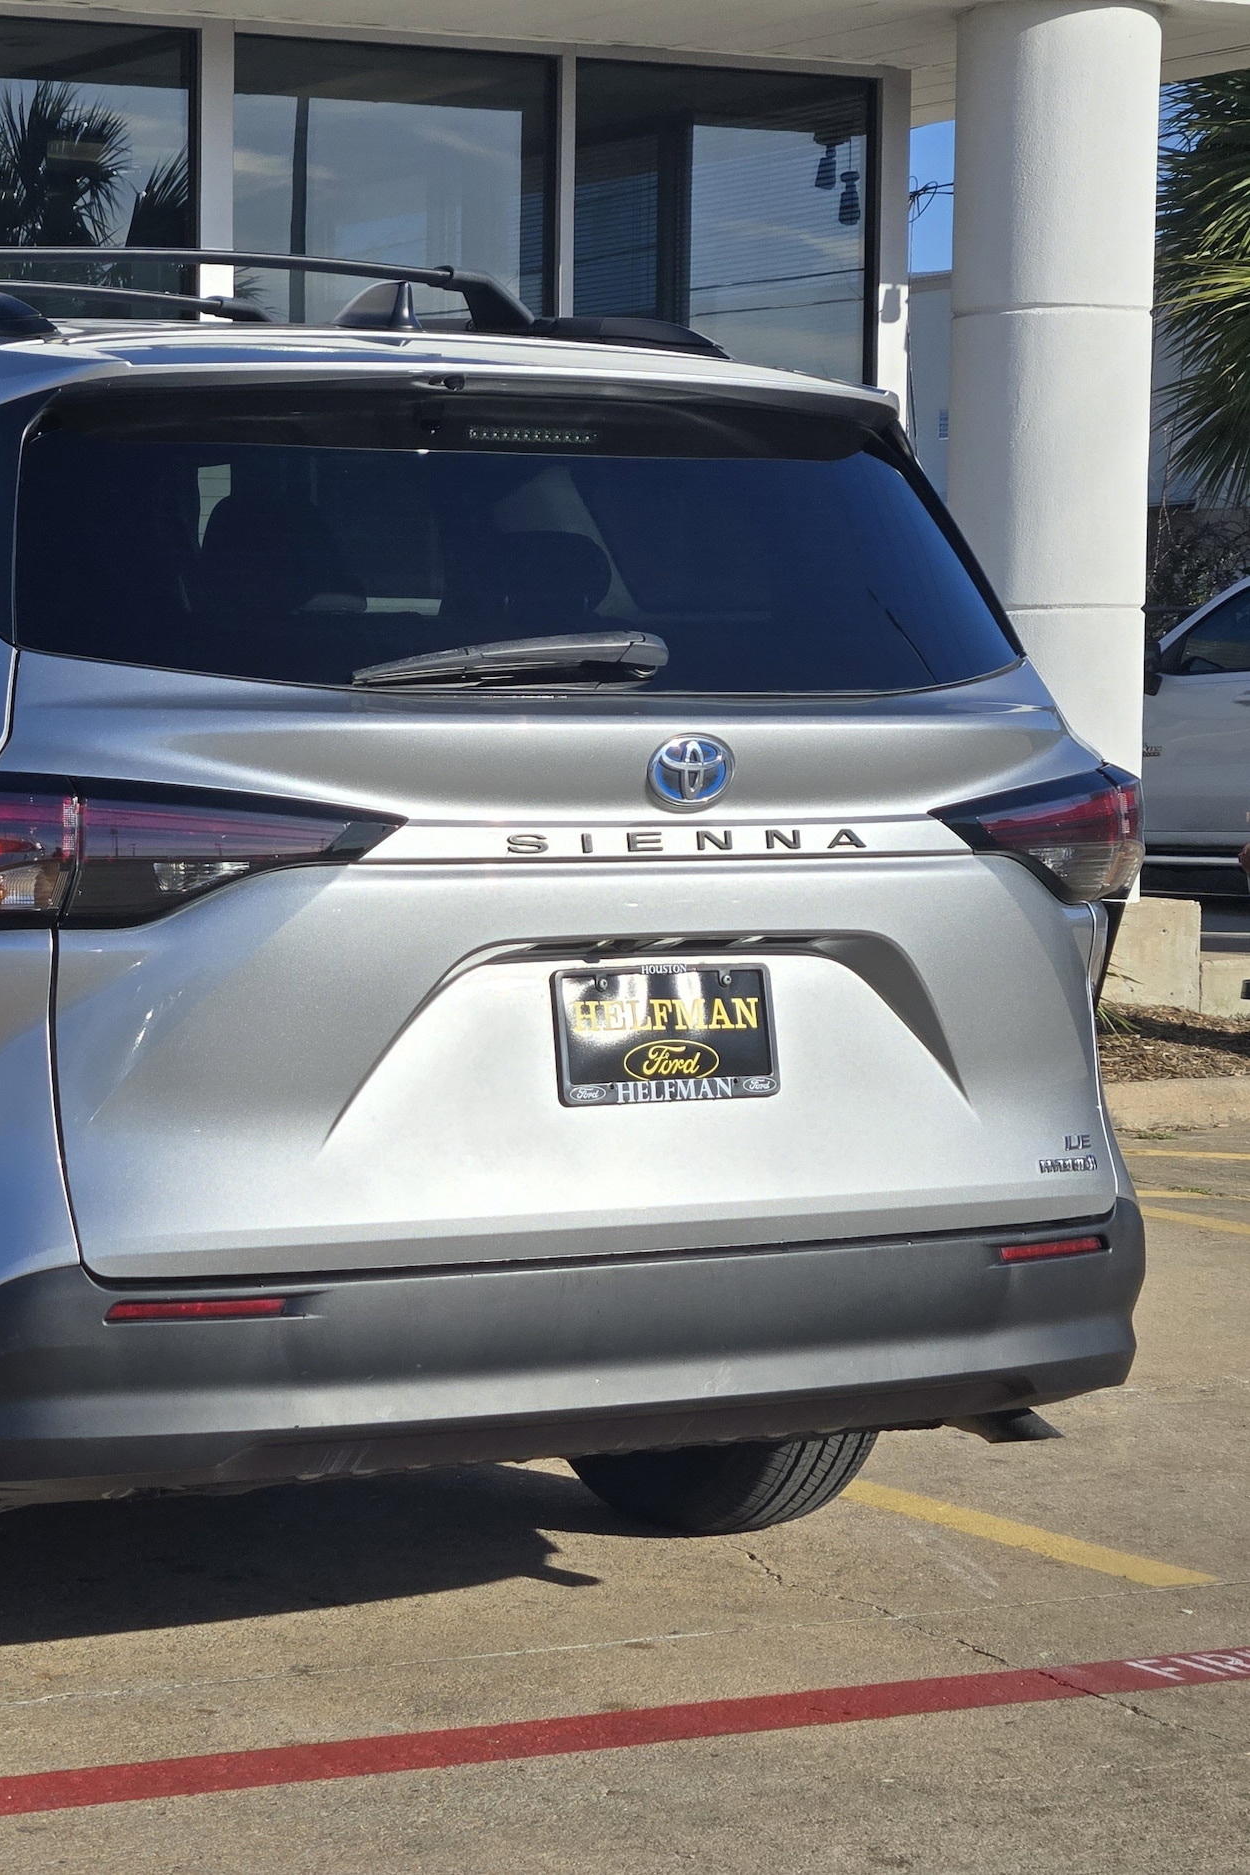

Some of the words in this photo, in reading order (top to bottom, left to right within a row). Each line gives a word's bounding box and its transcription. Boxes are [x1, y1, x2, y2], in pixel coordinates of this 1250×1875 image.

[507, 829, 867, 854] SIENNA
[641, 963, 688, 975] HOUSTON
[574, 998, 759, 1032] HELFMAN
[642, 1045, 701, 1075] Ford
[576, 1087, 600, 1099] Ford
[616, 1077, 733, 1104] HELFMAN
[749, 1077, 771, 1090] Ford
[1123, 1650, 1250, 1682] FIR
